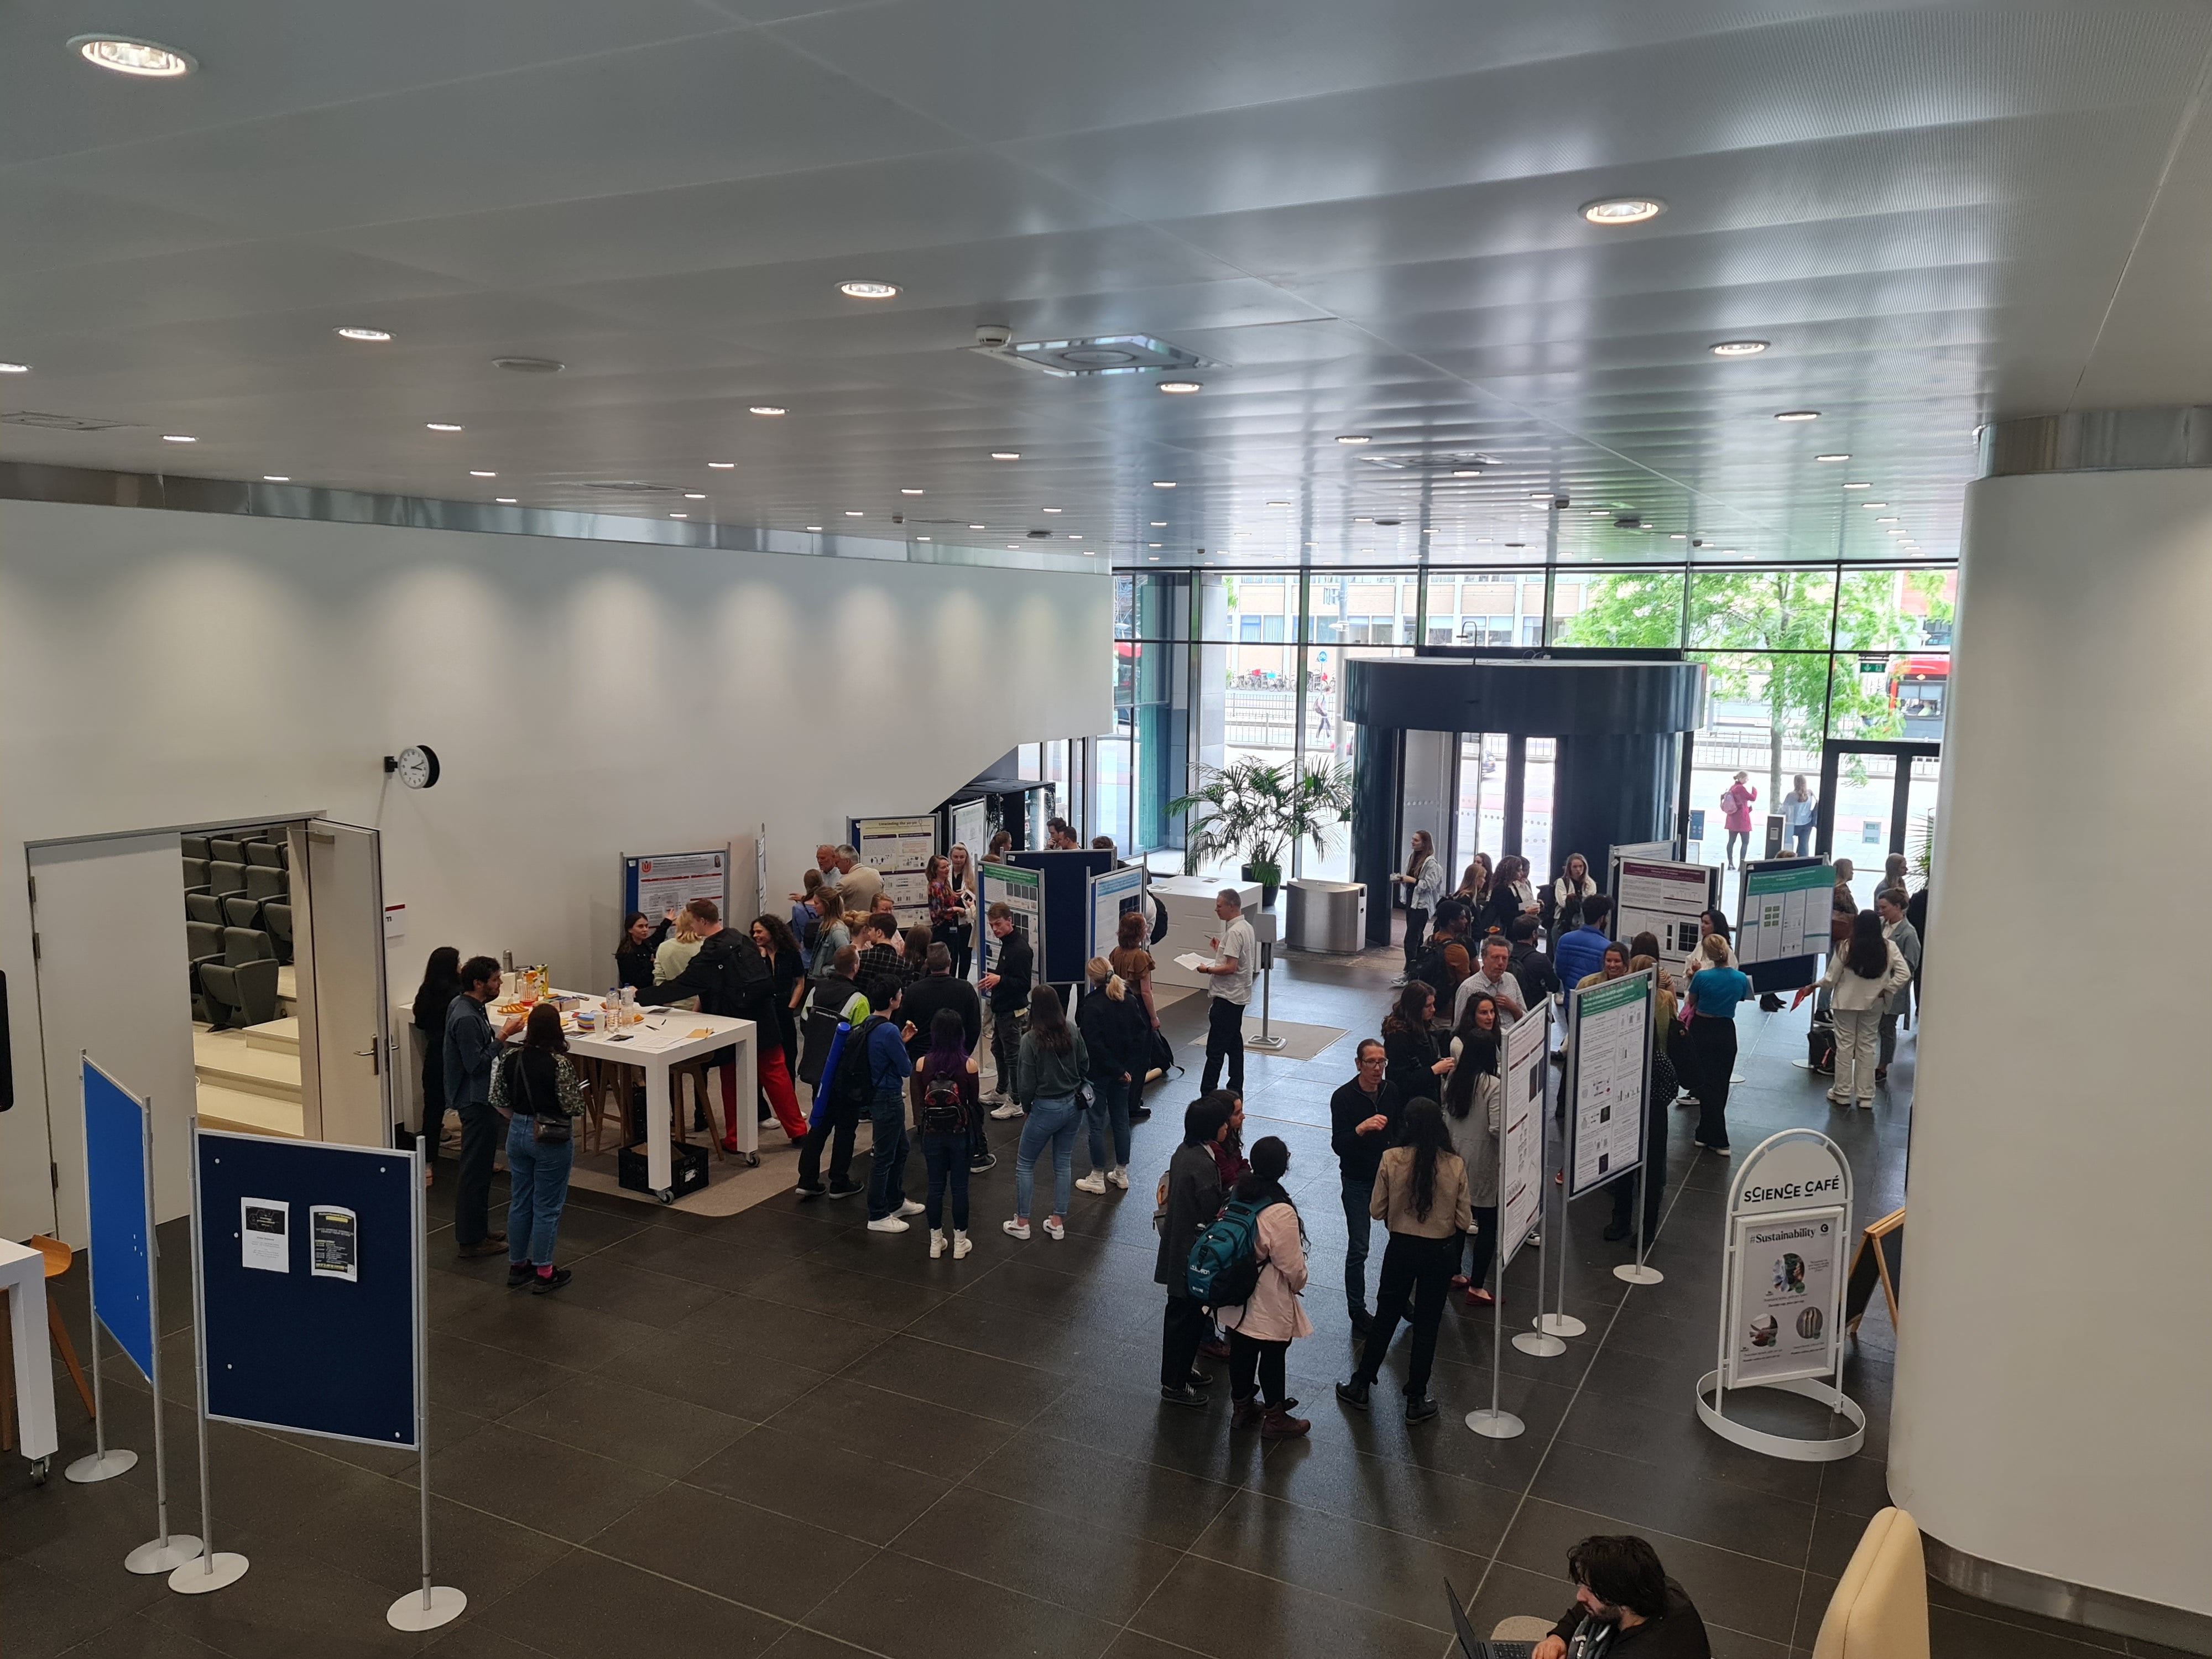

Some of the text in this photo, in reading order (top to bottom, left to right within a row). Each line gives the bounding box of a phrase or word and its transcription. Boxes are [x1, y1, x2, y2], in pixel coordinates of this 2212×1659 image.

[1744, 1175, 1839, 1202] SCIENCE CAFÉ
[1750, 1228, 1816, 1244] #Sustainability
